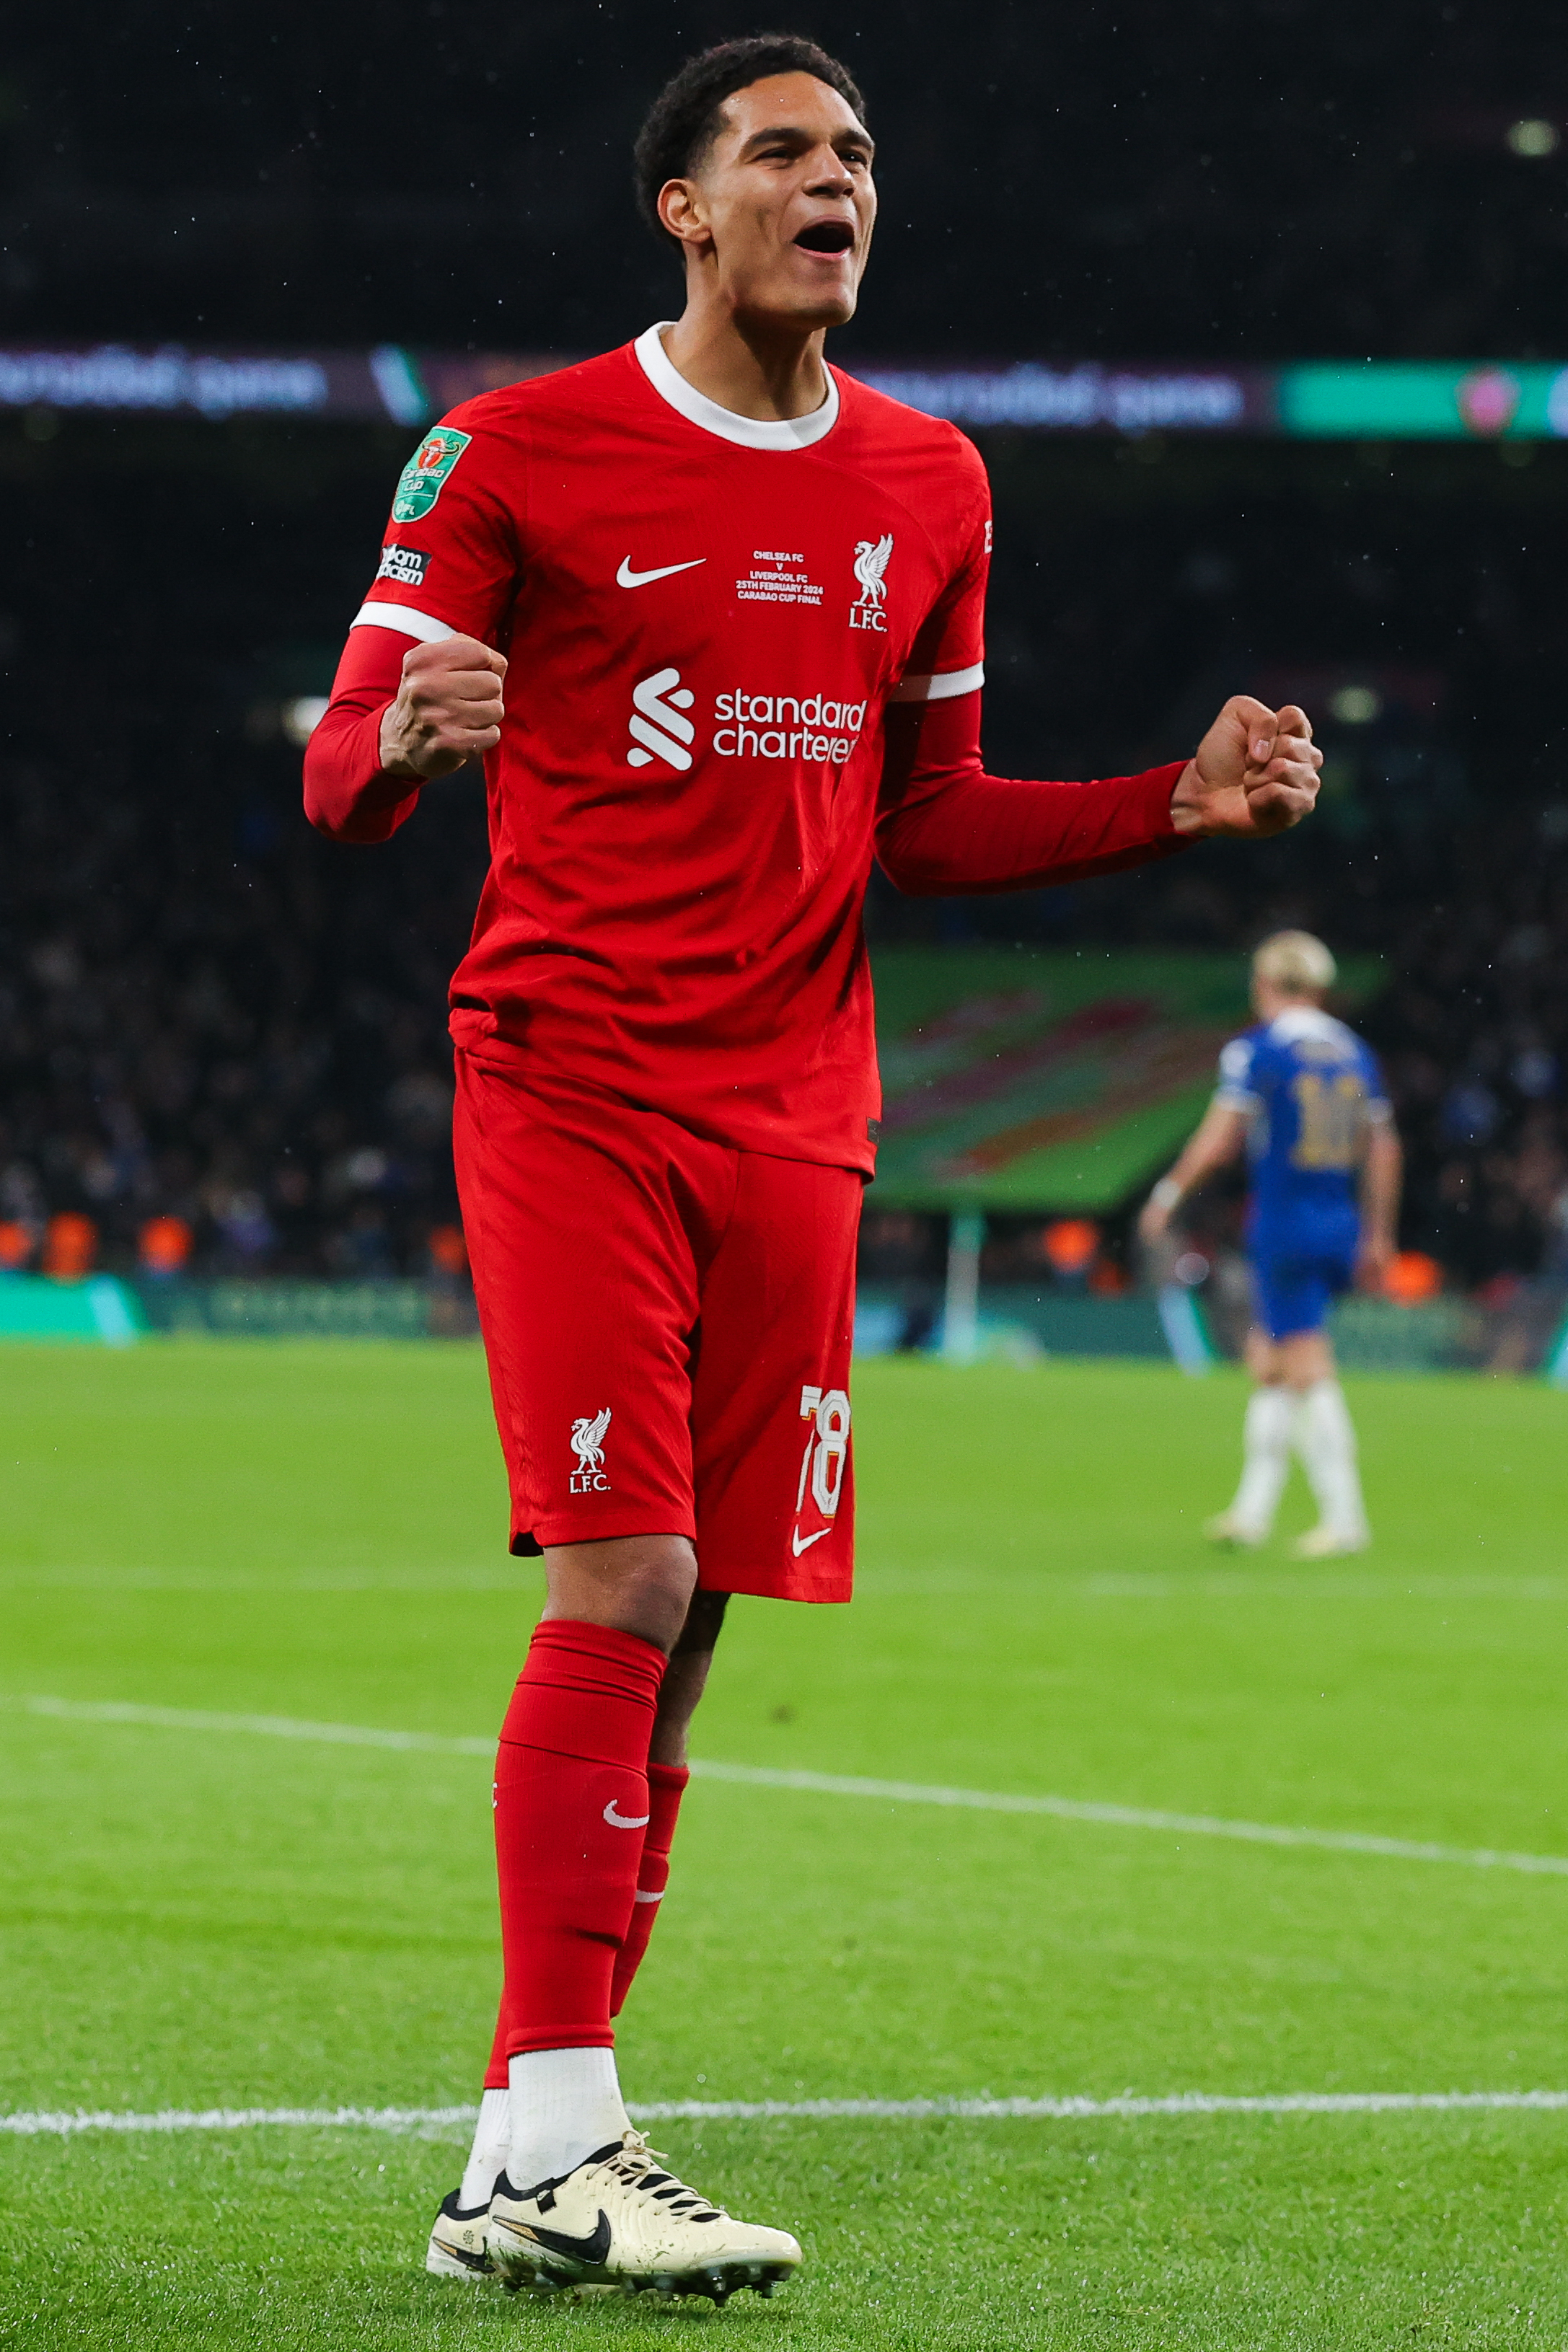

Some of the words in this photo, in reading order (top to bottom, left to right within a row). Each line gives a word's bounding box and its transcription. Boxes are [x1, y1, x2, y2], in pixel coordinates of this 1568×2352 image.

[753, 550, 792, 562] CHELSEA
[792, 553, 804, 563] FC
[776, 562, 783, 571] V
[749, 571, 796, 583] LIVERPOOL
[796, 574, 808, 583] FC
[736, 580, 759, 589] 25TH
[759, 581, 802, 593] FEBRUARY
[803, 585, 824, 595] 2024
[737, 591, 778, 602] CARABAO
[778, 593, 796, 602] CUP
[797, 595, 822, 605] FINAL
[849, 607, 888, 633] L.F.C.
[714, 687, 868, 732] standard
[569, 1474, 612, 1494] L.F.C.
